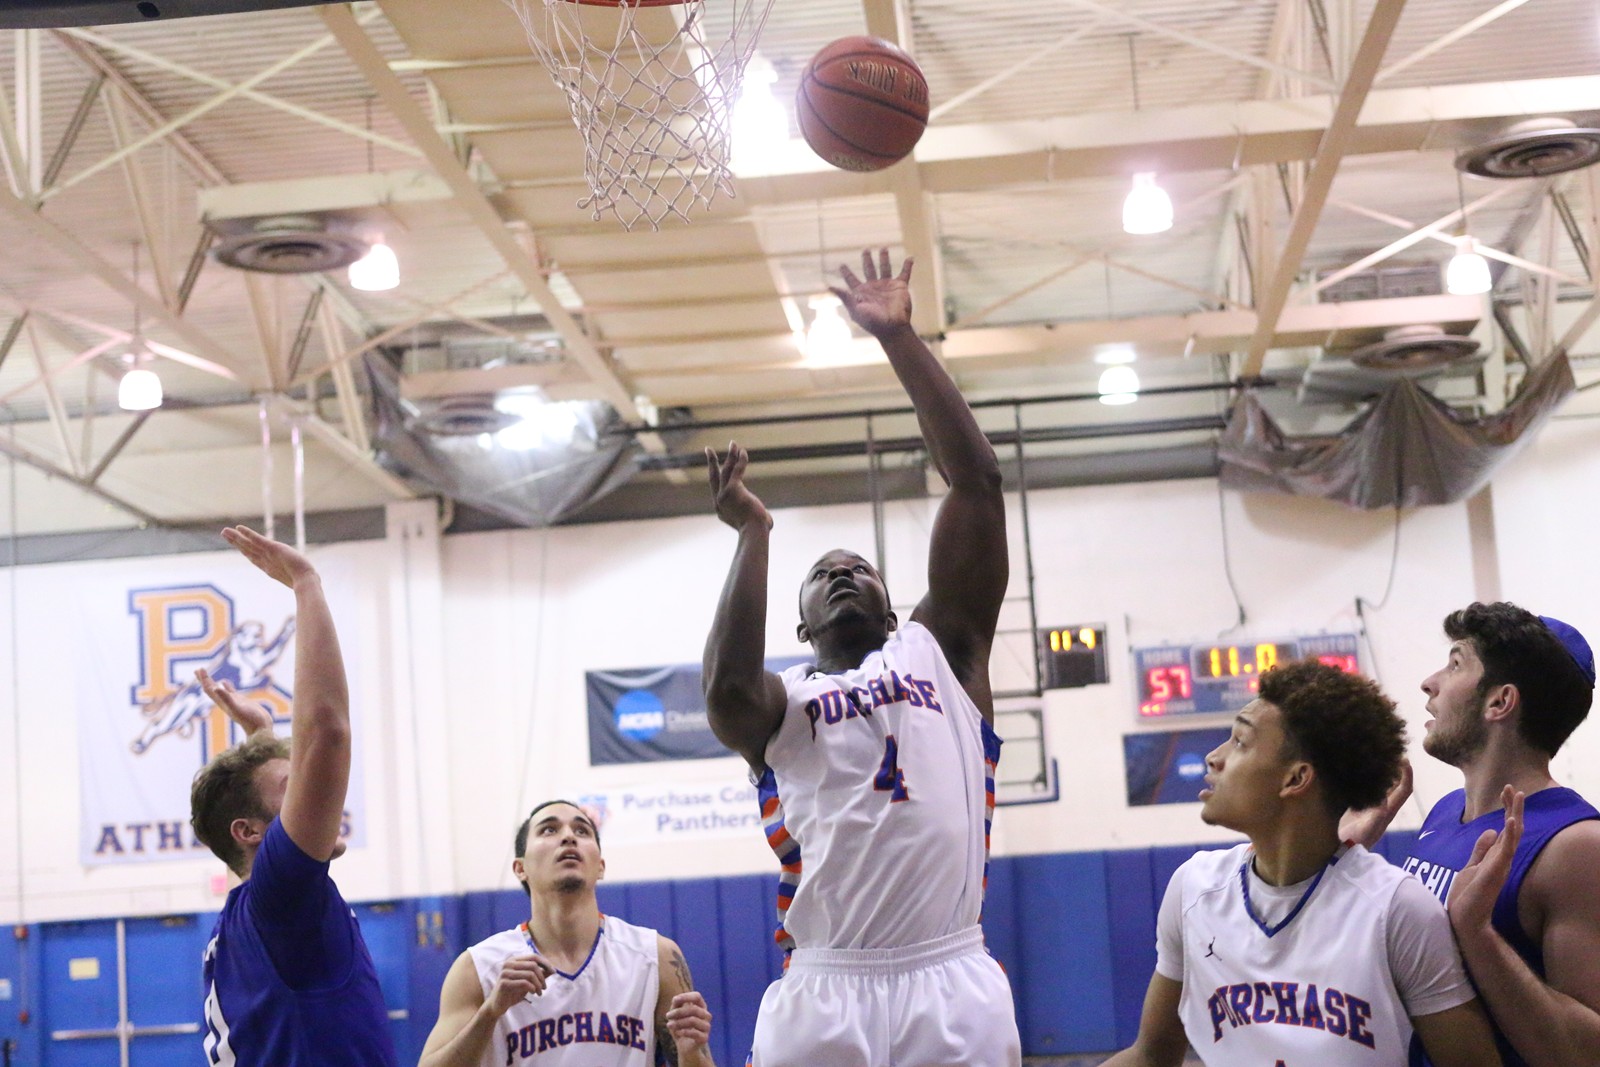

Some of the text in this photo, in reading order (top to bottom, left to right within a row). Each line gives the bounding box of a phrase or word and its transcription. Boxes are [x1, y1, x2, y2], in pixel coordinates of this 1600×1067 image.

[804, 670, 944, 742] PURCHASE
[1149, 665, 1192, 701] 57
[622, 786, 757, 809] Purchase Coll
[873, 734, 910, 804] 4
[505, 1011, 646, 1067] PURCHASE
[1207, 981, 1376, 1050] PURCHASE
